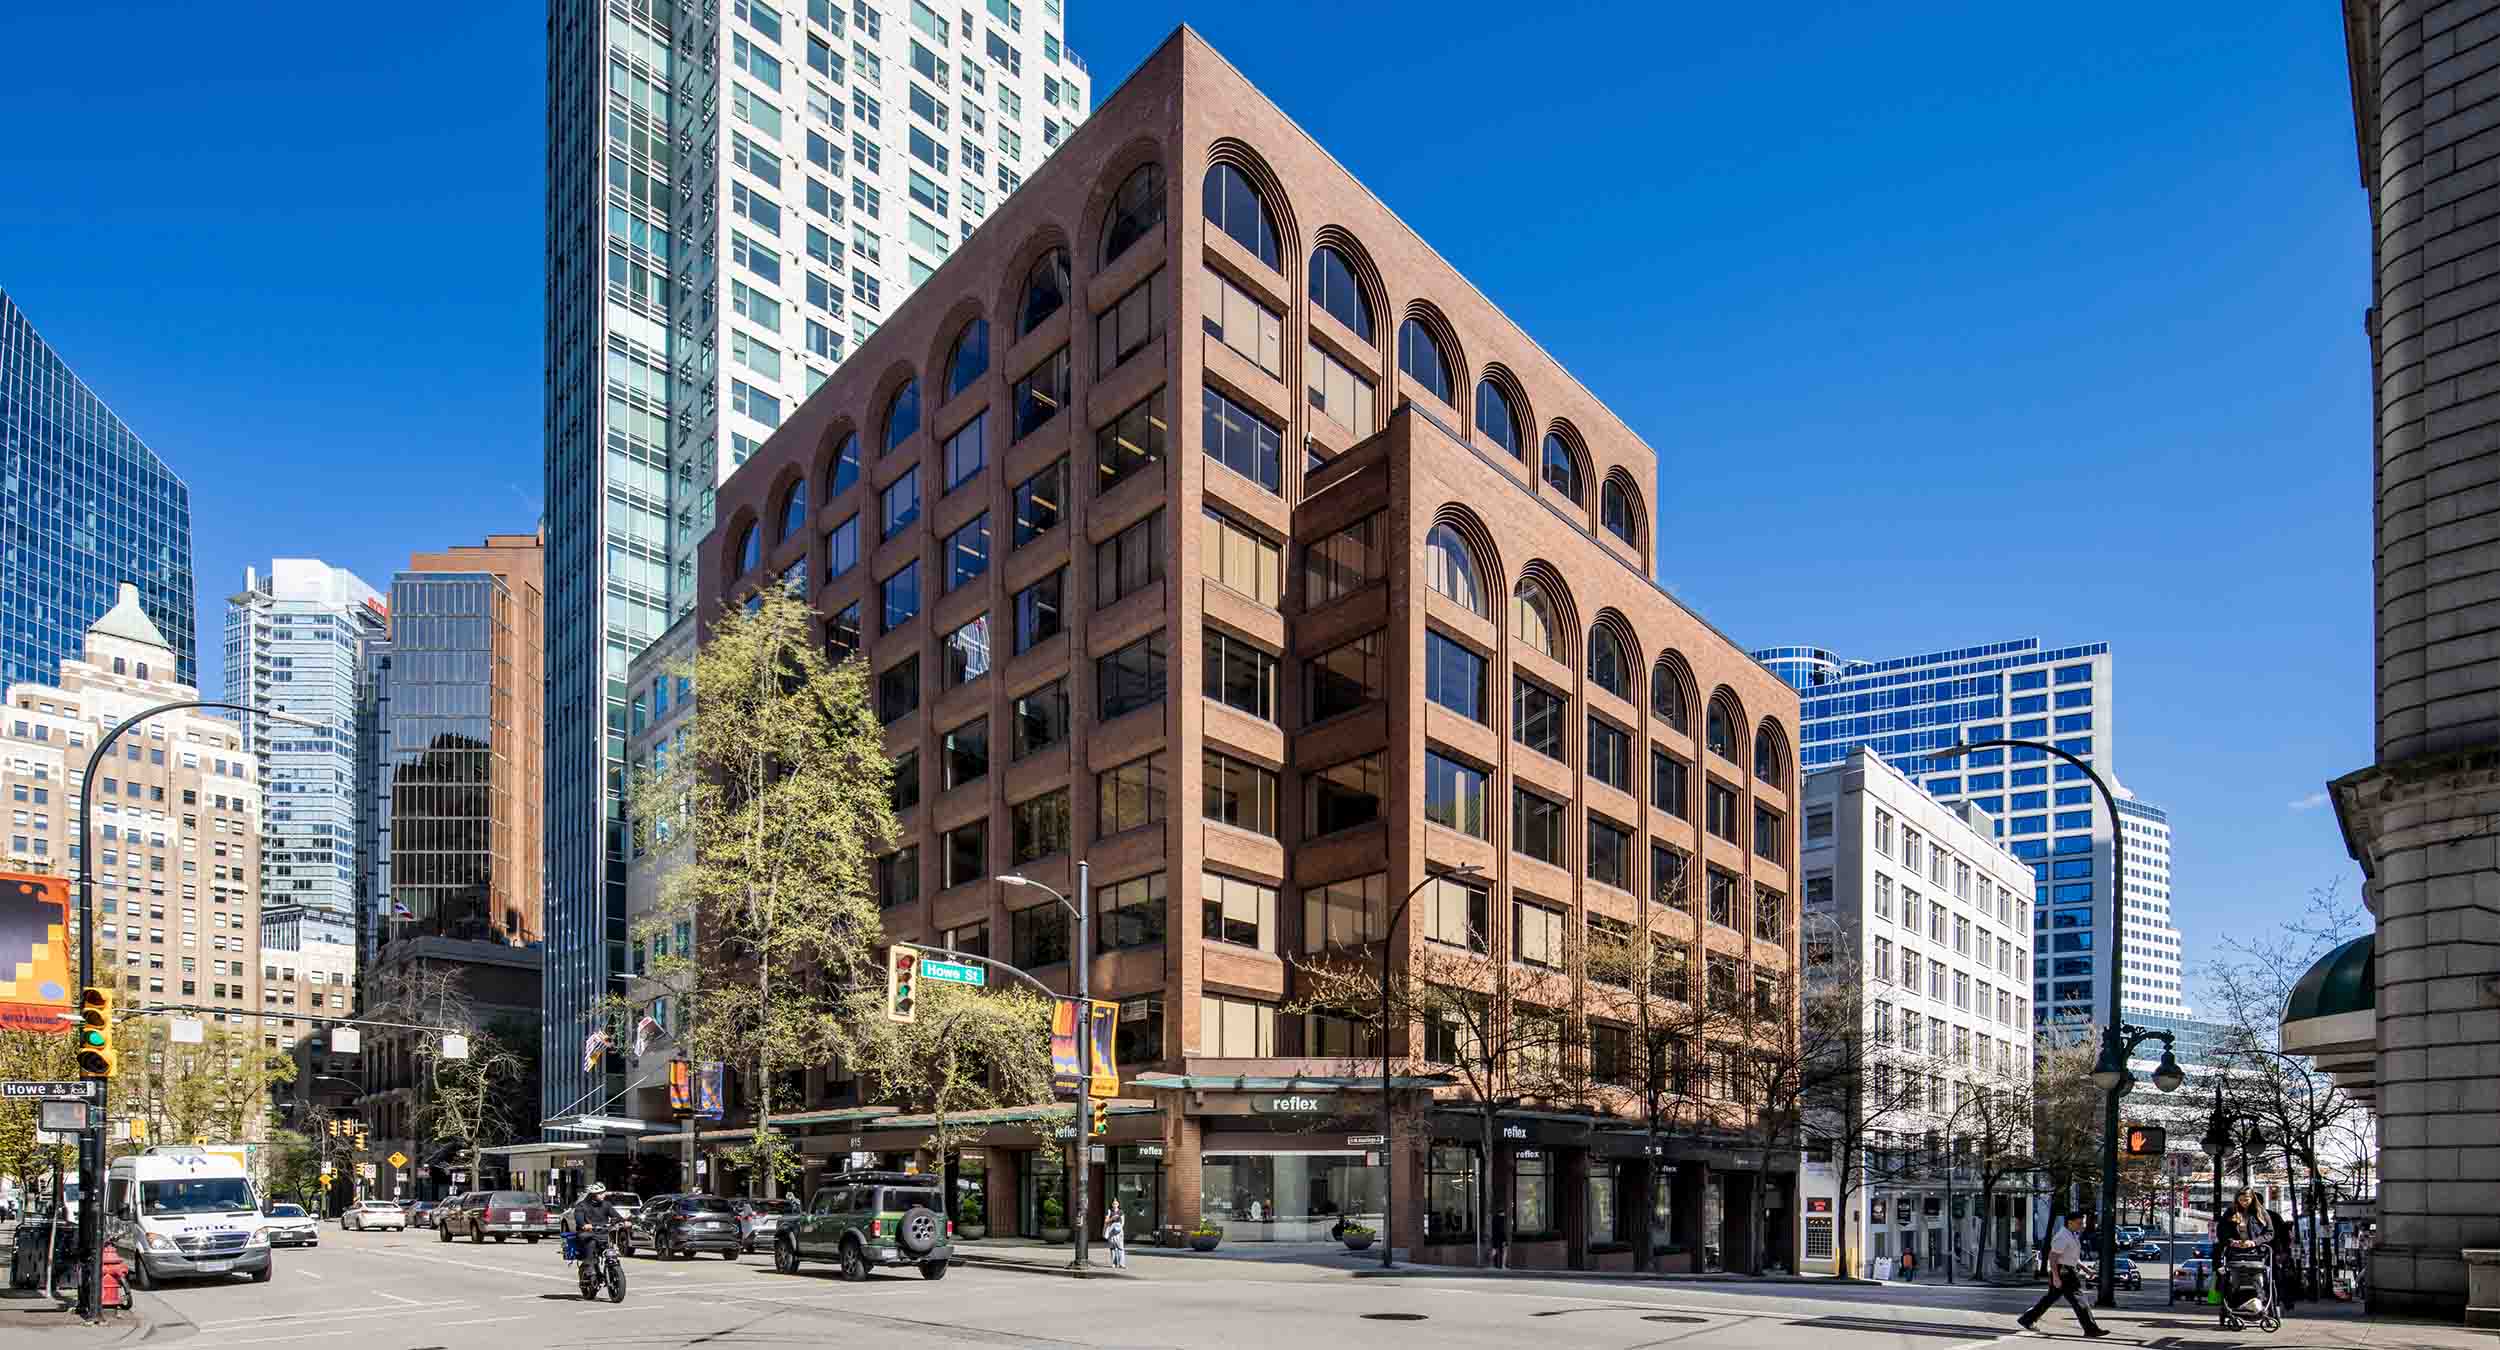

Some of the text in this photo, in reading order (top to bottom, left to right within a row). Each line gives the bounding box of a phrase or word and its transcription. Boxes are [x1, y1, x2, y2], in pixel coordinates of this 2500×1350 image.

[927, 963, 978, 980] Howe St
[7, 1084, 46, 1095] Howe
[1272, 1095, 1318, 1111] reflex
[1503, 1125, 1527, 1139] reflex
[1139, 1146, 1163, 1156] reflex
[1515, 1150, 1540, 1159] reflex
